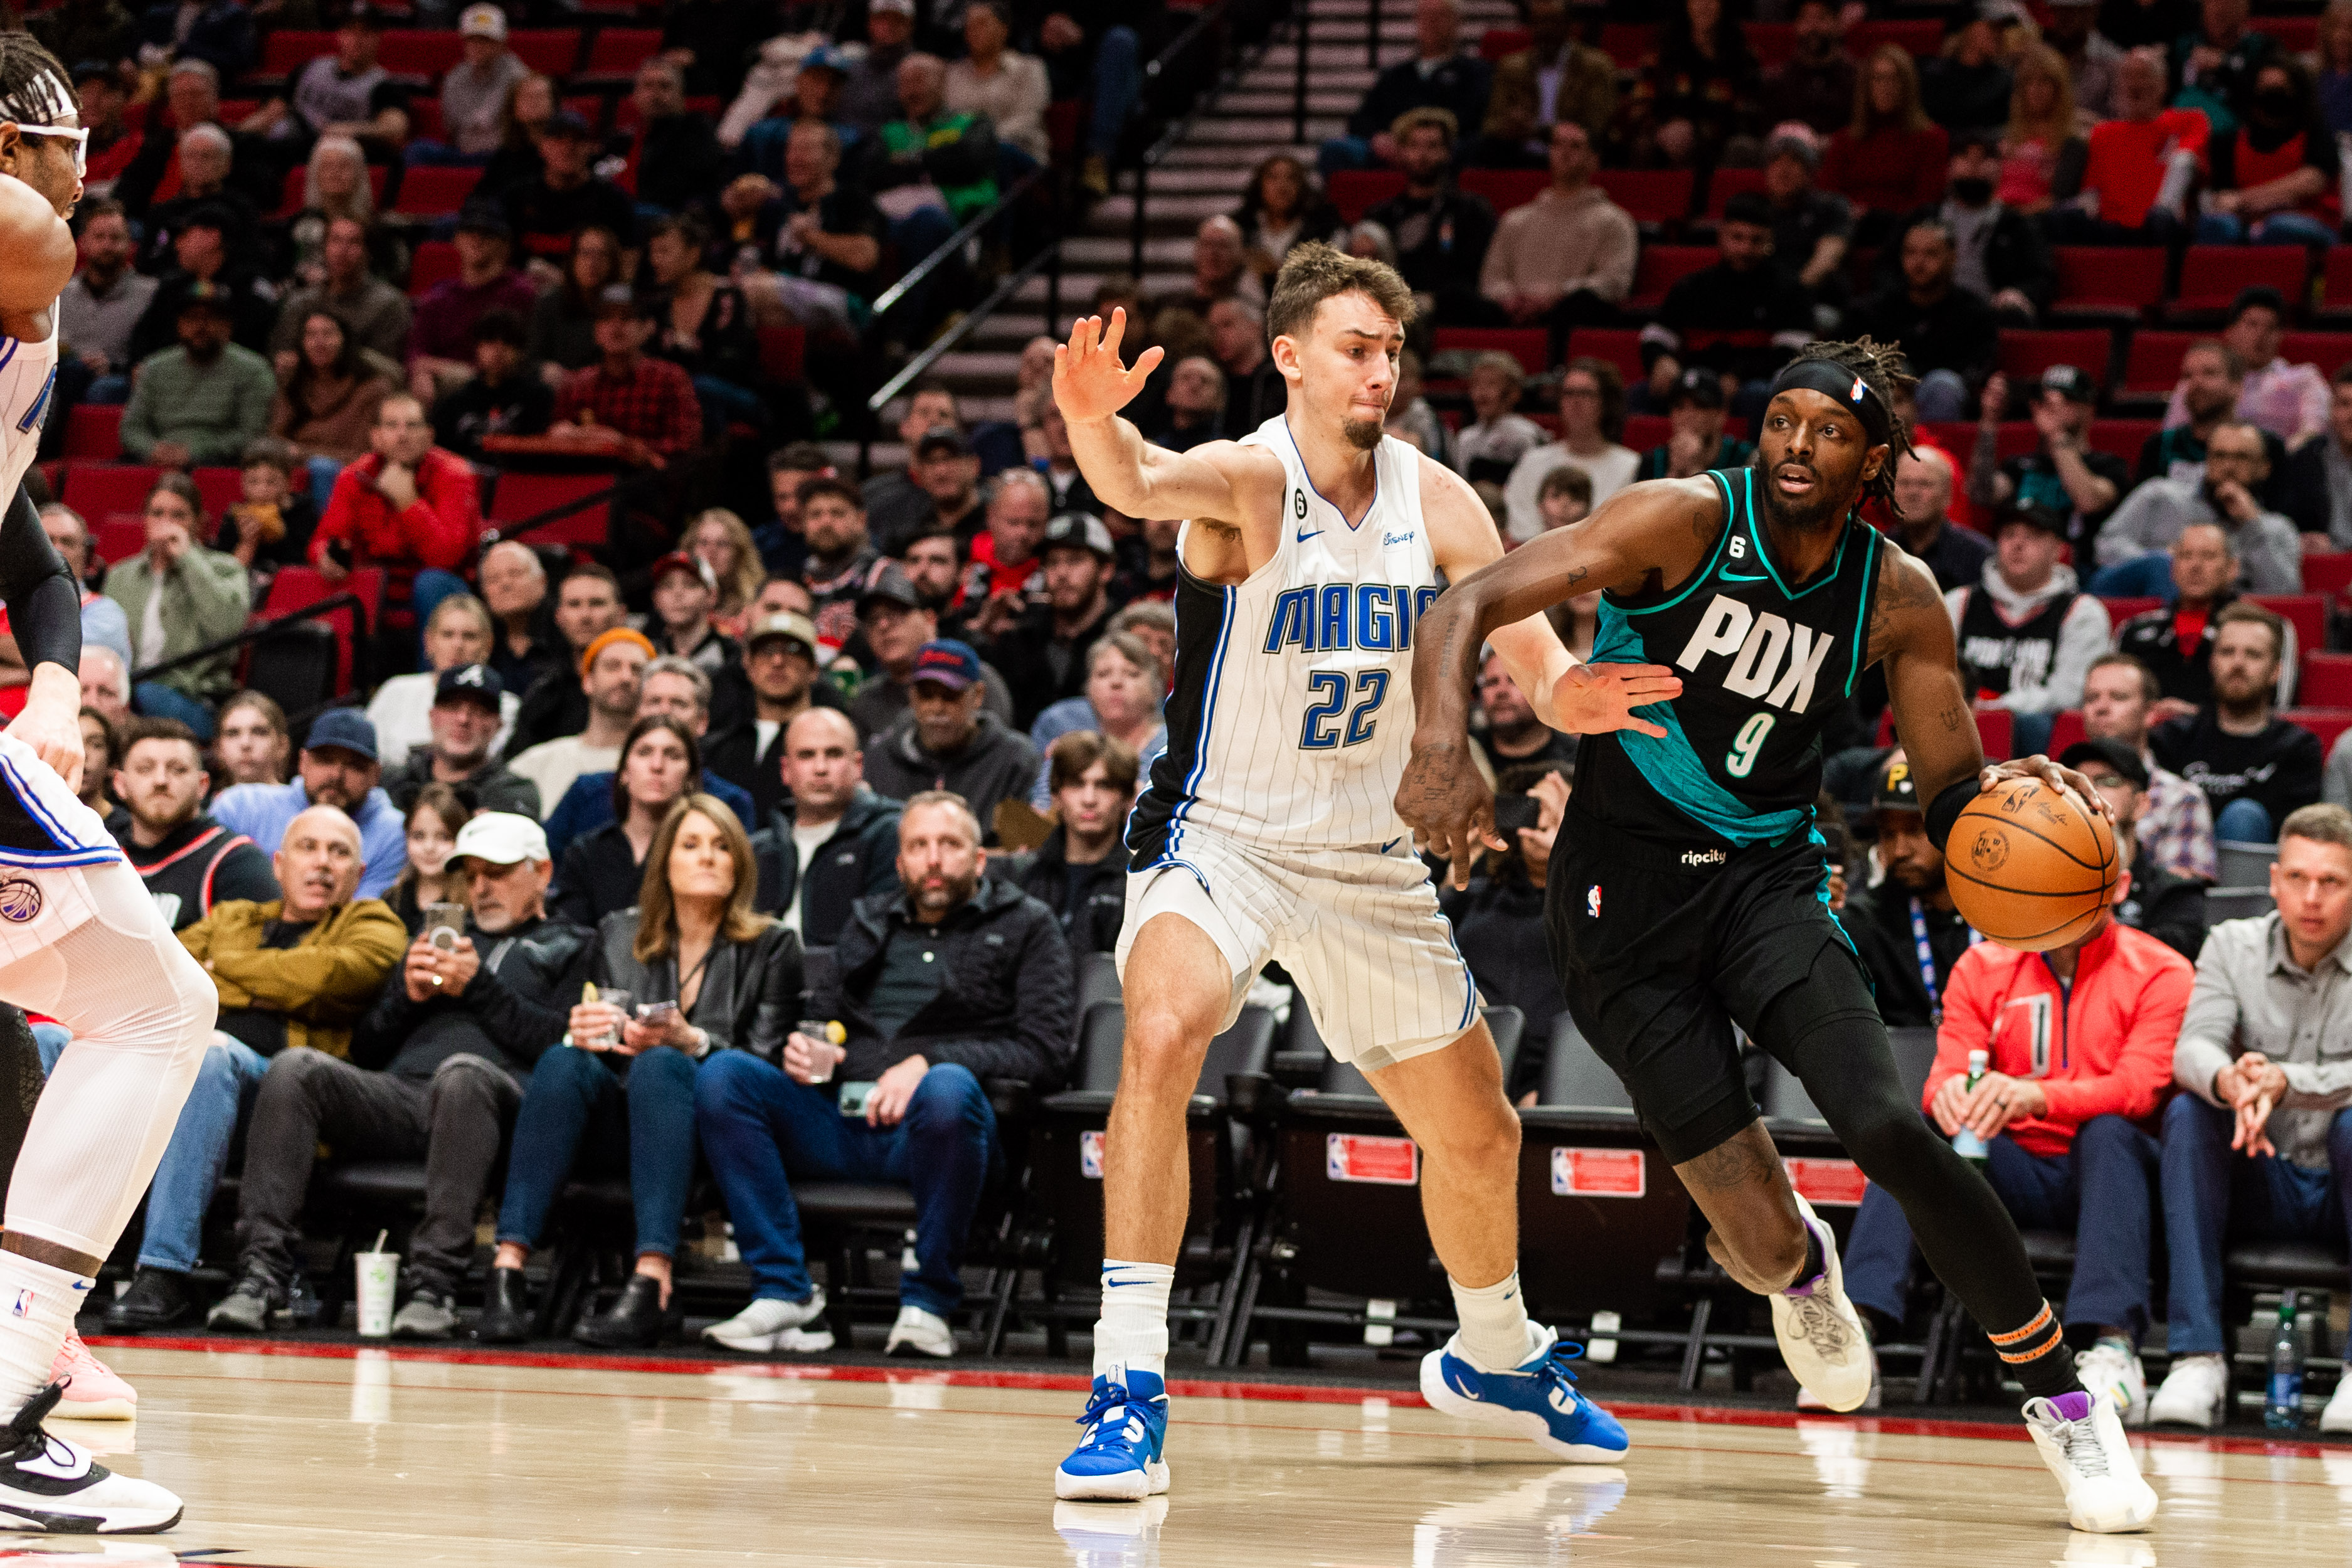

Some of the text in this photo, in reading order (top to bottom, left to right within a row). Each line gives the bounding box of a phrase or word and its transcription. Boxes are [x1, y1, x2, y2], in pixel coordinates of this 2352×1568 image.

[1296, 492, 1305, 516] 6
[1729, 535, 1746, 559] 6
[1675, 593, 1835, 714] PDX
[1298, 668, 1391, 750] 22
[1725, 712, 1776, 778] 9
[1681, 849, 1727, 867] ripcity
